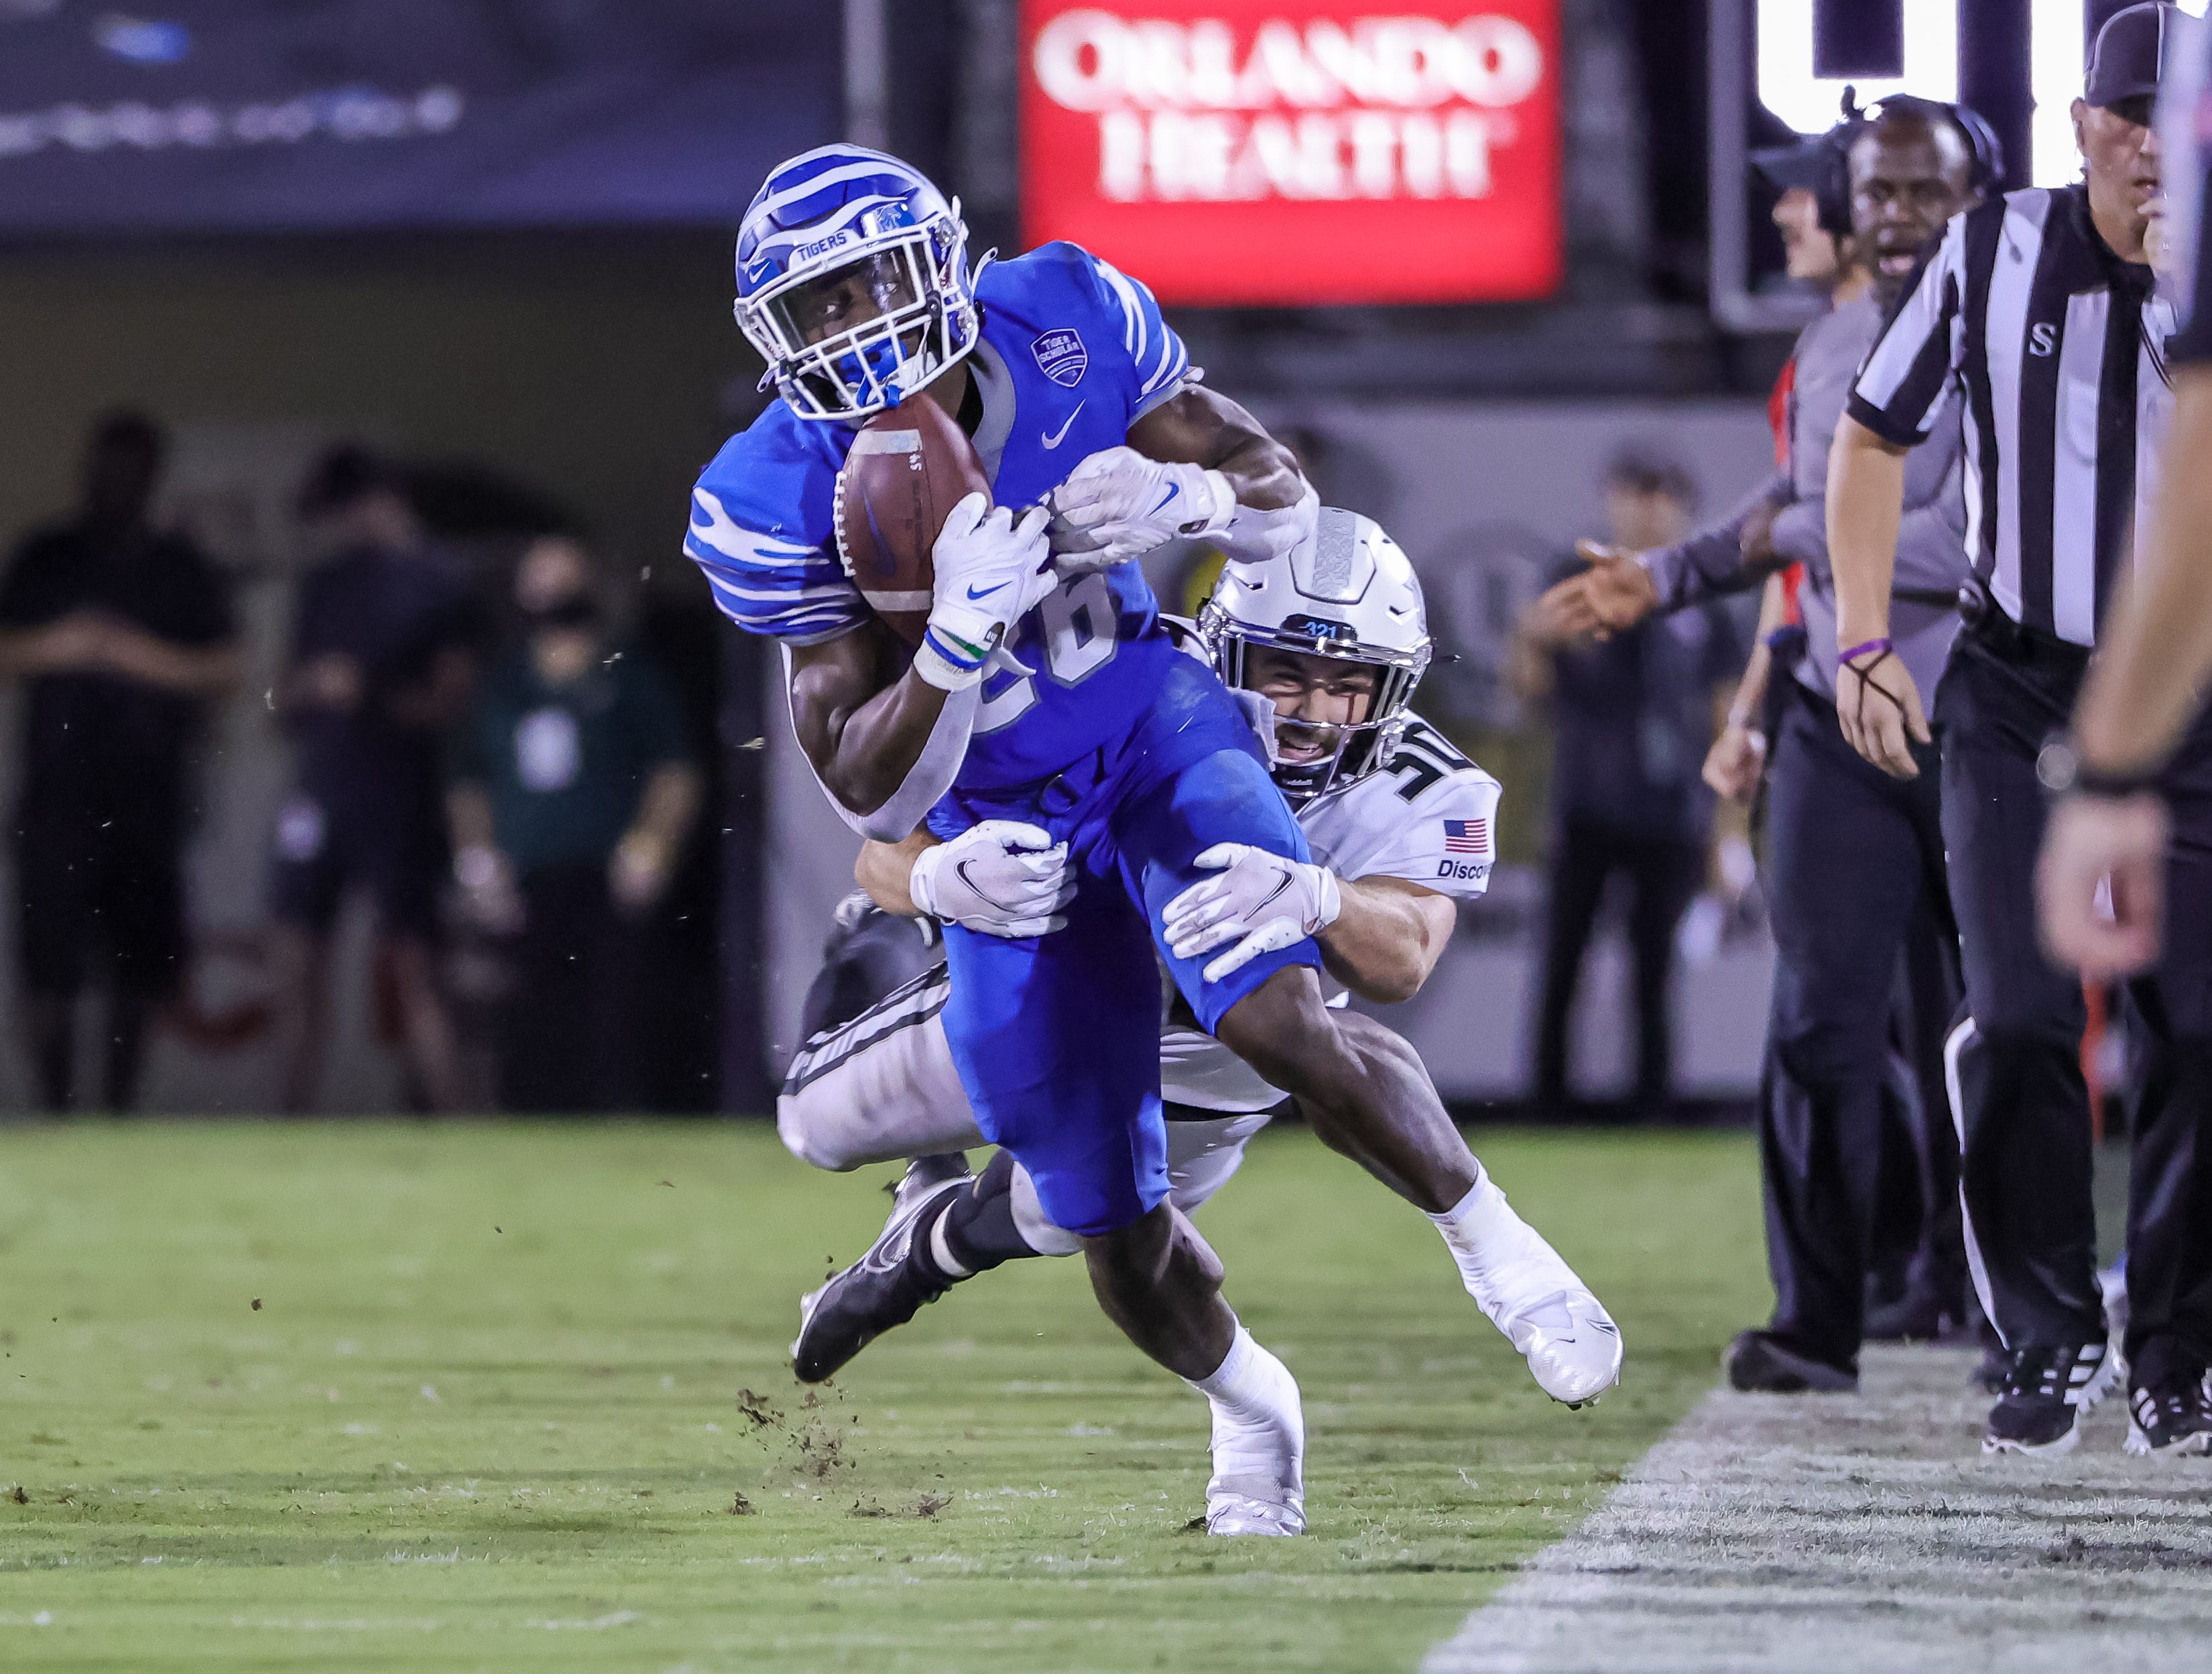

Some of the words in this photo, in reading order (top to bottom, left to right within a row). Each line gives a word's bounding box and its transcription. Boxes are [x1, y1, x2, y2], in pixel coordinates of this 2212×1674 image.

[1034, 9, 1543, 113] ORLANDO
[1099, 109, 1491, 203] HEALTH
[798, 232, 848, 262] TIGERS
[2028, 322, 2056, 358] S
[1305, 621, 1337, 639] 321
